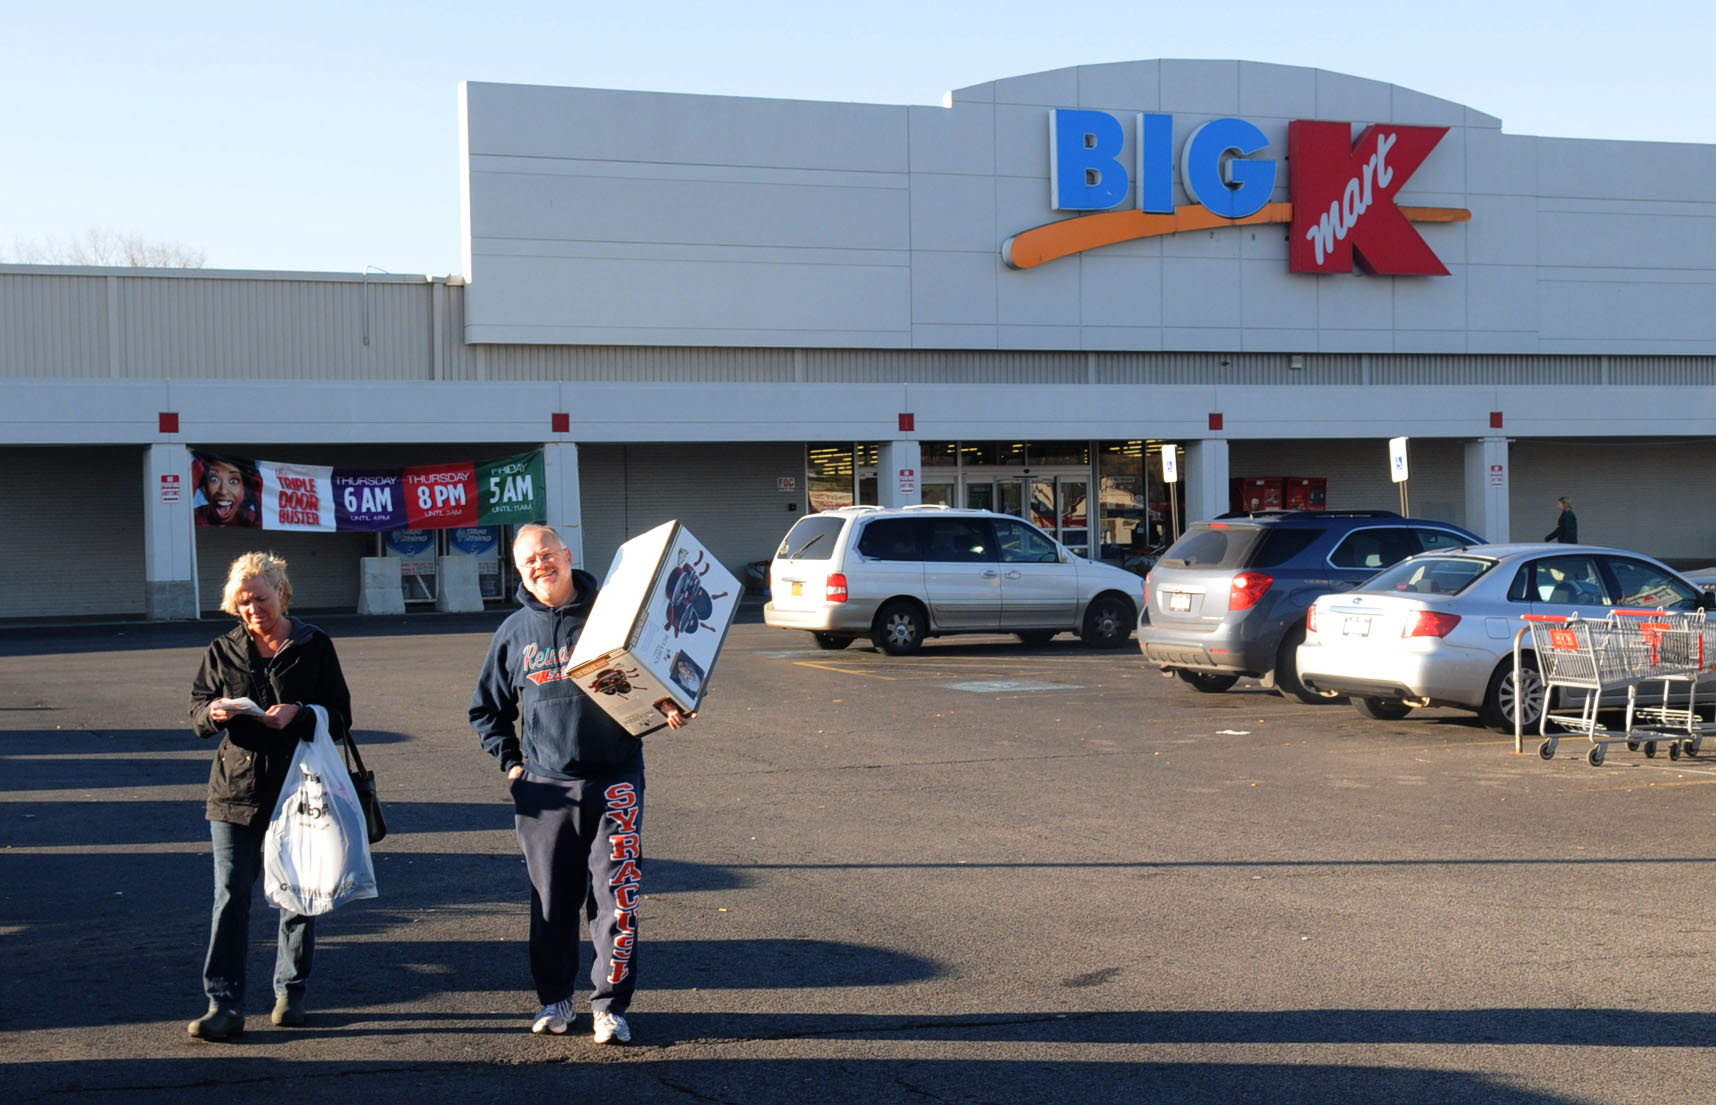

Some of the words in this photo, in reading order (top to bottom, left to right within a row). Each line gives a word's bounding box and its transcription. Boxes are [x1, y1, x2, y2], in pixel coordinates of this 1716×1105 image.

[1049, 108, 1277, 219] BIG
[1289, 119, 1452, 276] K
[1306, 132, 1397, 266] mart
[407, 471, 470, 485] THURSDAY
[491, 463, 528, 475] FRIDAY
[276, 475, 317, 494] TRIPLE
[336, 475, 398, 486] THURSDAY
[489, 477, 501, 504] 5
[503, 474, 533, 503] AM
[278, 490, 320, 511] DOOR
[343, 486, 358, 513] 6
[361, 486, 393, 513] AM
[417, 485, 433, 510] 8
[434, 483, 467, 508] PM
[278, 509, 321, 526] BUSTER
[424, 510, 444, 518] UNTIL
[491, 505, 512, 513] UNTIL
